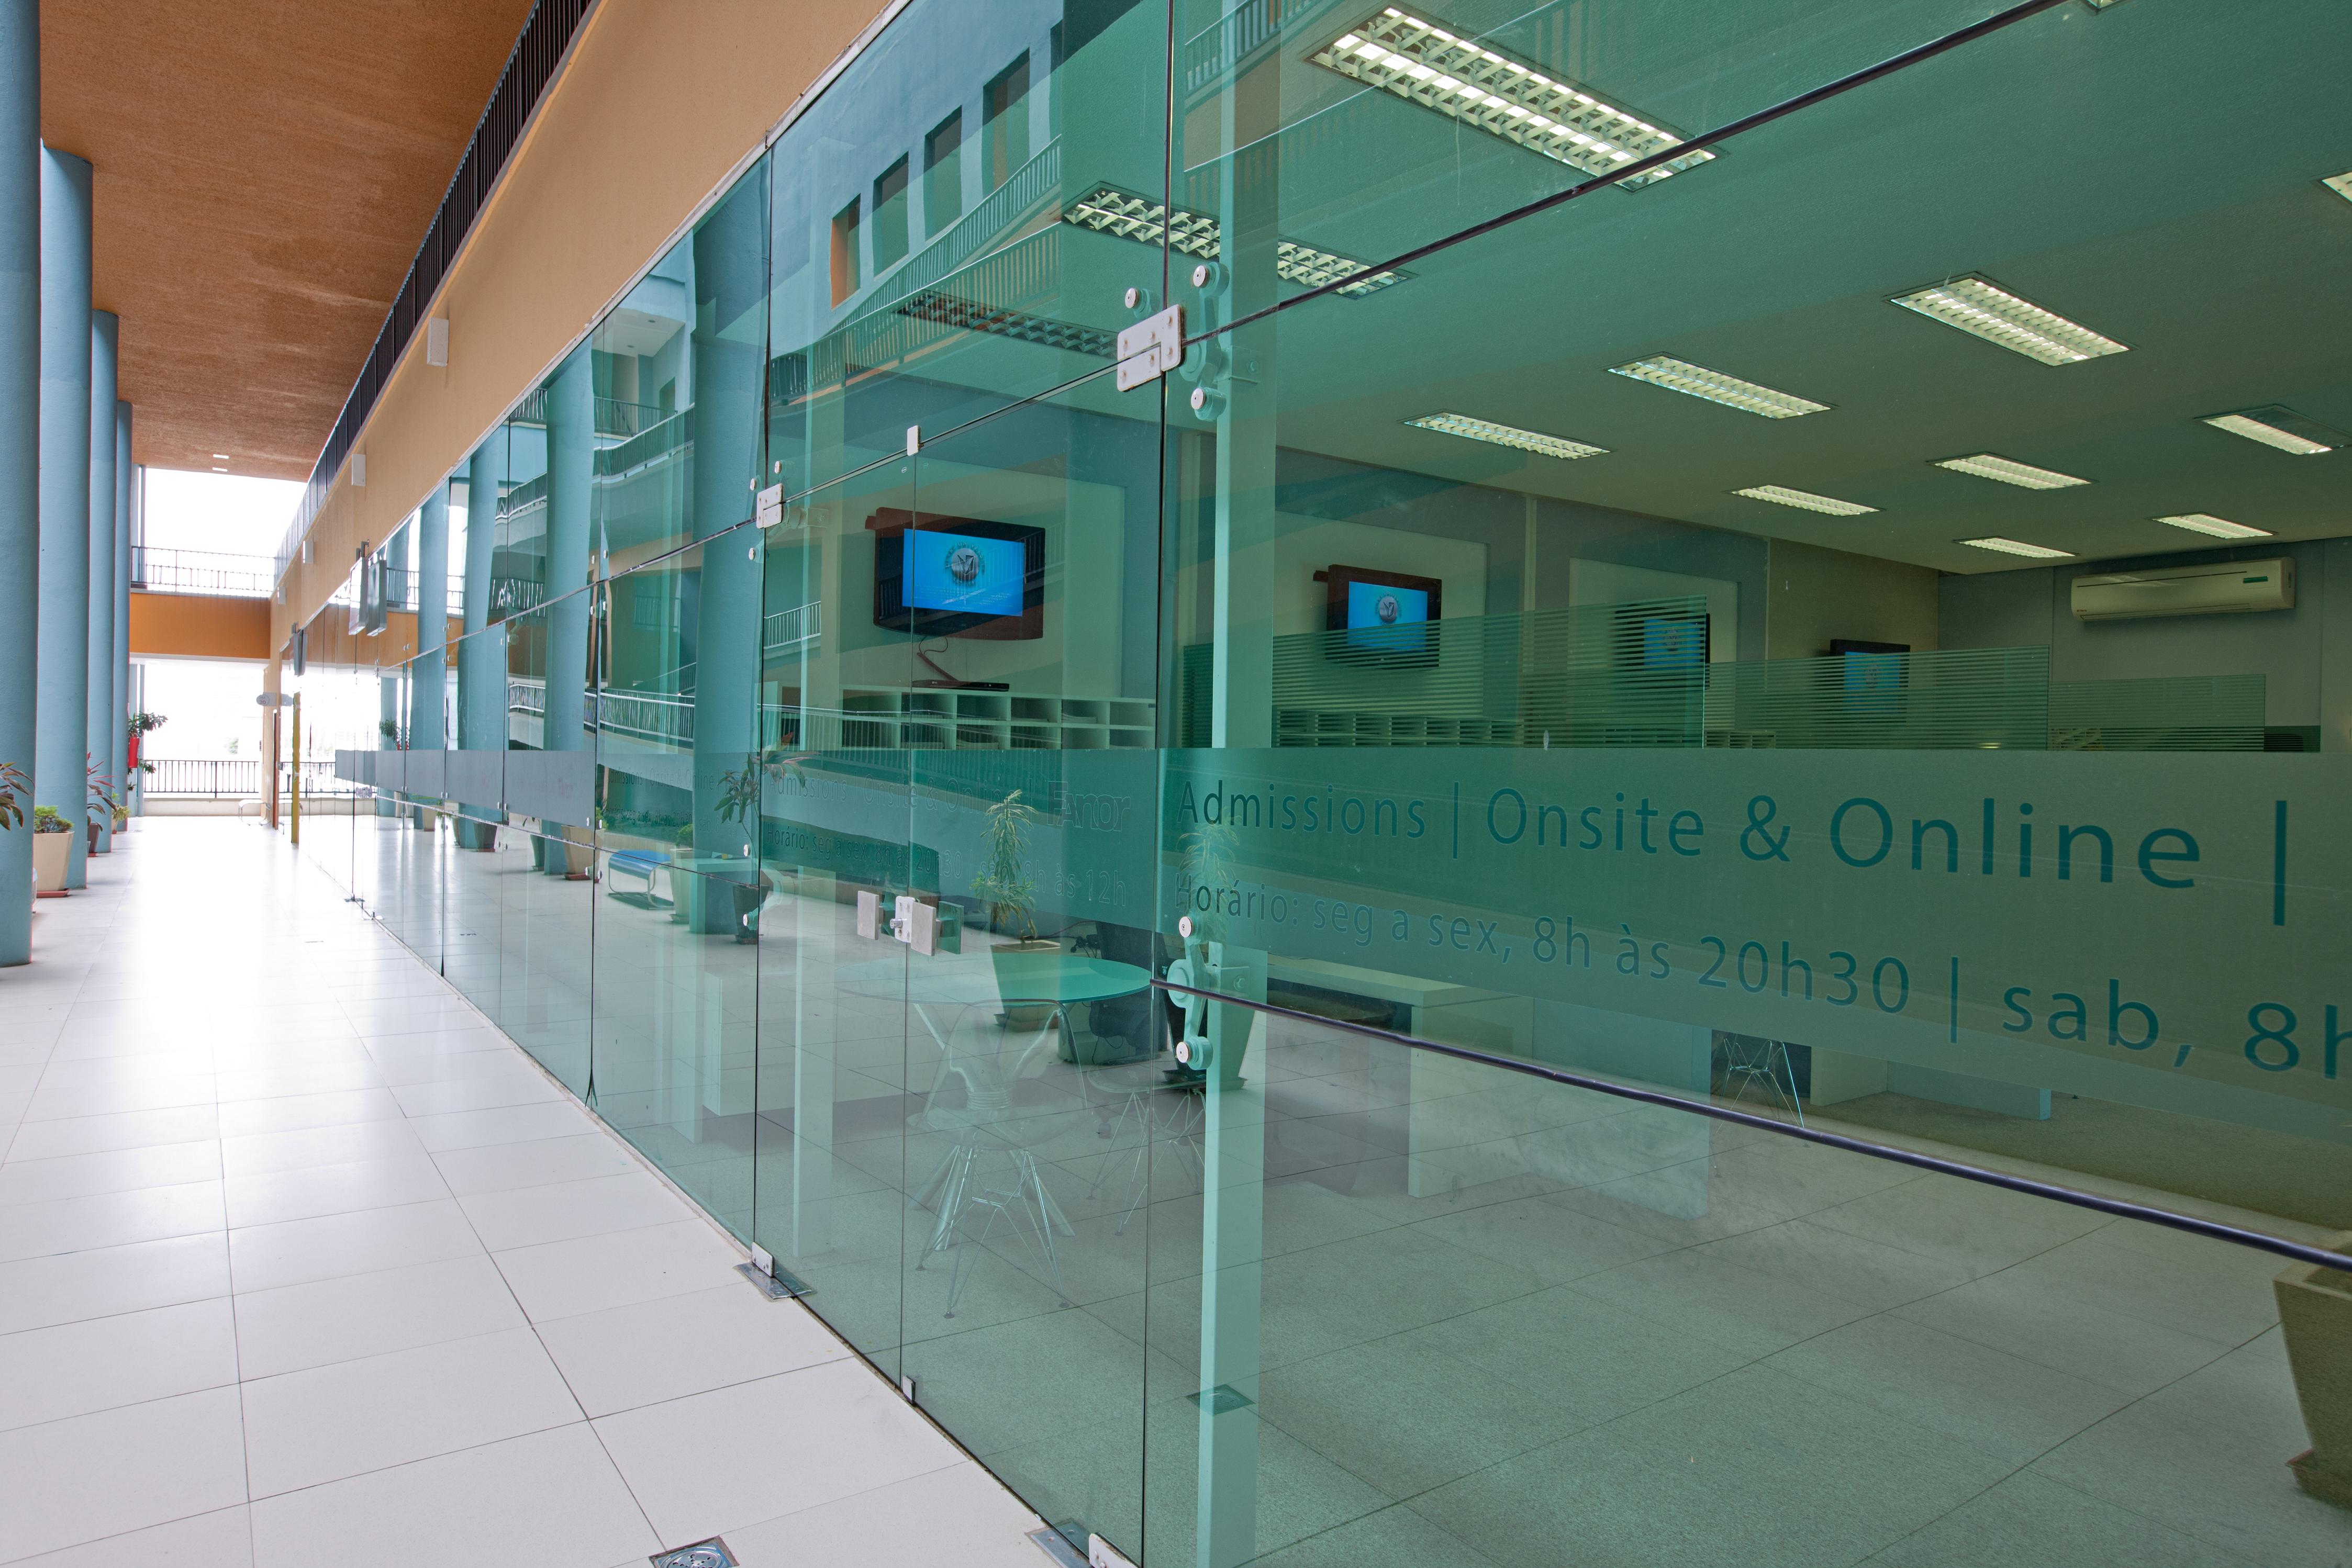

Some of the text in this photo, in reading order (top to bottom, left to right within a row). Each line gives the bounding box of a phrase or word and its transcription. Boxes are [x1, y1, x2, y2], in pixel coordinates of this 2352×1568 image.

[768, 769, 847, 802] Admissions
[863, 774, 918, 809] Onsite
[925, 777, 938, 812] &
[1176, 779, 1426, 838] Admissions
[1487, 788, 1704, 857] Onsite
[1739, 794, 1791, 863] &
[1830, 797, 2201, 890] Online
[766, 823, 809, 850] Horário:
[812, 835, 831, 861] seg
[836, 838, 843, 854] a
[875, 839, 891, 866] 8h
[915, 846, 963, 879] 20h30
[1023, 860, 1046, 893] 8h
[1054, 864, 1076, 898] às
[1086, 869, 1127, 907] 12h
[1175, 873, 1298, 926] Horário:
[1312, 898, 1375, 950] seg
[1392, 909, 1410, 943] a
[1429, 913, 1512, 965] sex,
[1532, 916, 1592, 969] 8h
[1616, 923, 1672, 980] às
[1698, 935, 1911, 1014] 20h30
[2002, 978, 2192, 1069] sab,
